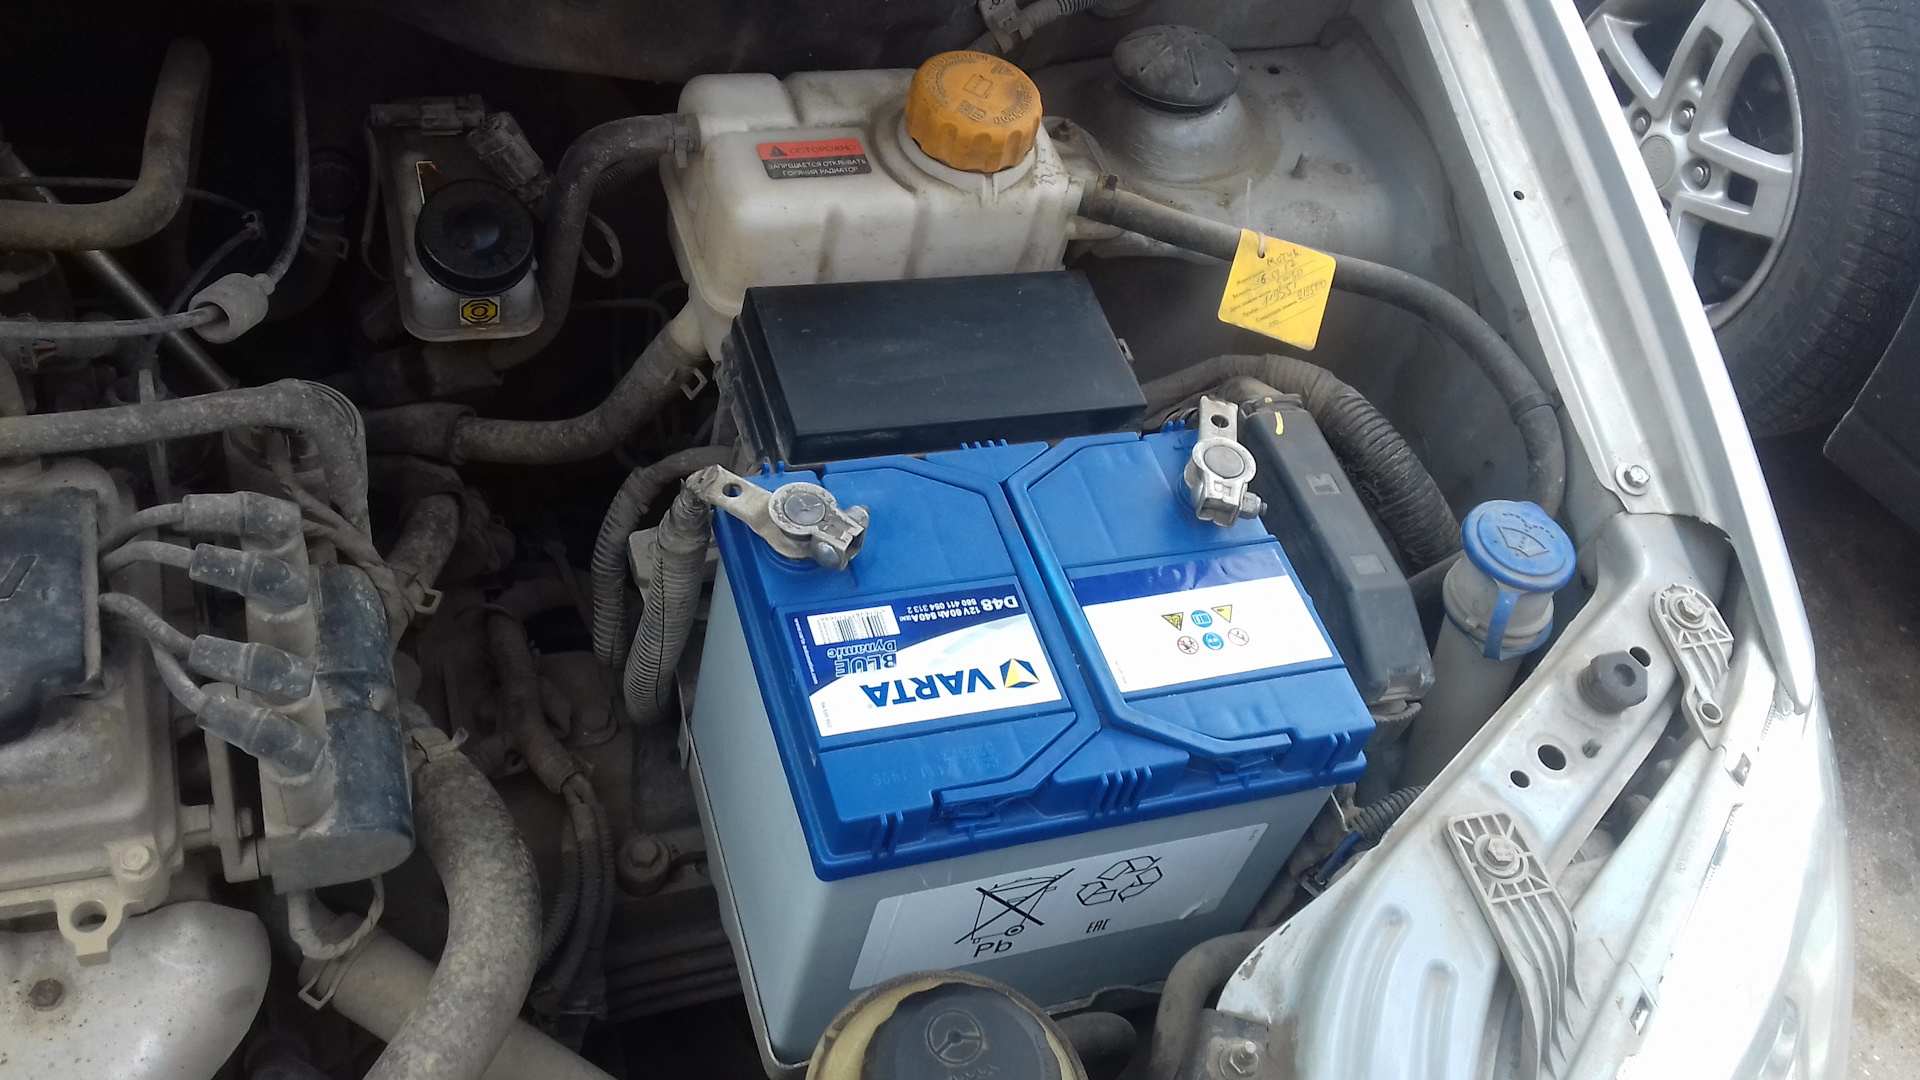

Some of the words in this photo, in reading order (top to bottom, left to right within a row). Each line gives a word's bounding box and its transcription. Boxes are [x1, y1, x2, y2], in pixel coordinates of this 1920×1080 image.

[789, 144, 856, 154] ОСТОРОЖНО
[769, 161, 821, 170] ЗАПРЕЩАЕТСЯ
[820, 166, 859, 174] РАДИАТОР
[946, 600, 961, 609] 411
[980, 595, 1019, 611] D48
[907, 606, 913, 614] 2
[913, 604, 929, 613] 313
[938, 608, 963, 619] 60Ah
[963, 606, 981, 616] 12V
[827, 639, 898, 659] Dynamic
[835, 653, 897, 677] BLUE
[859, 668, 997, 708] VARTA
[973, 939, 1013, 958] Pb
